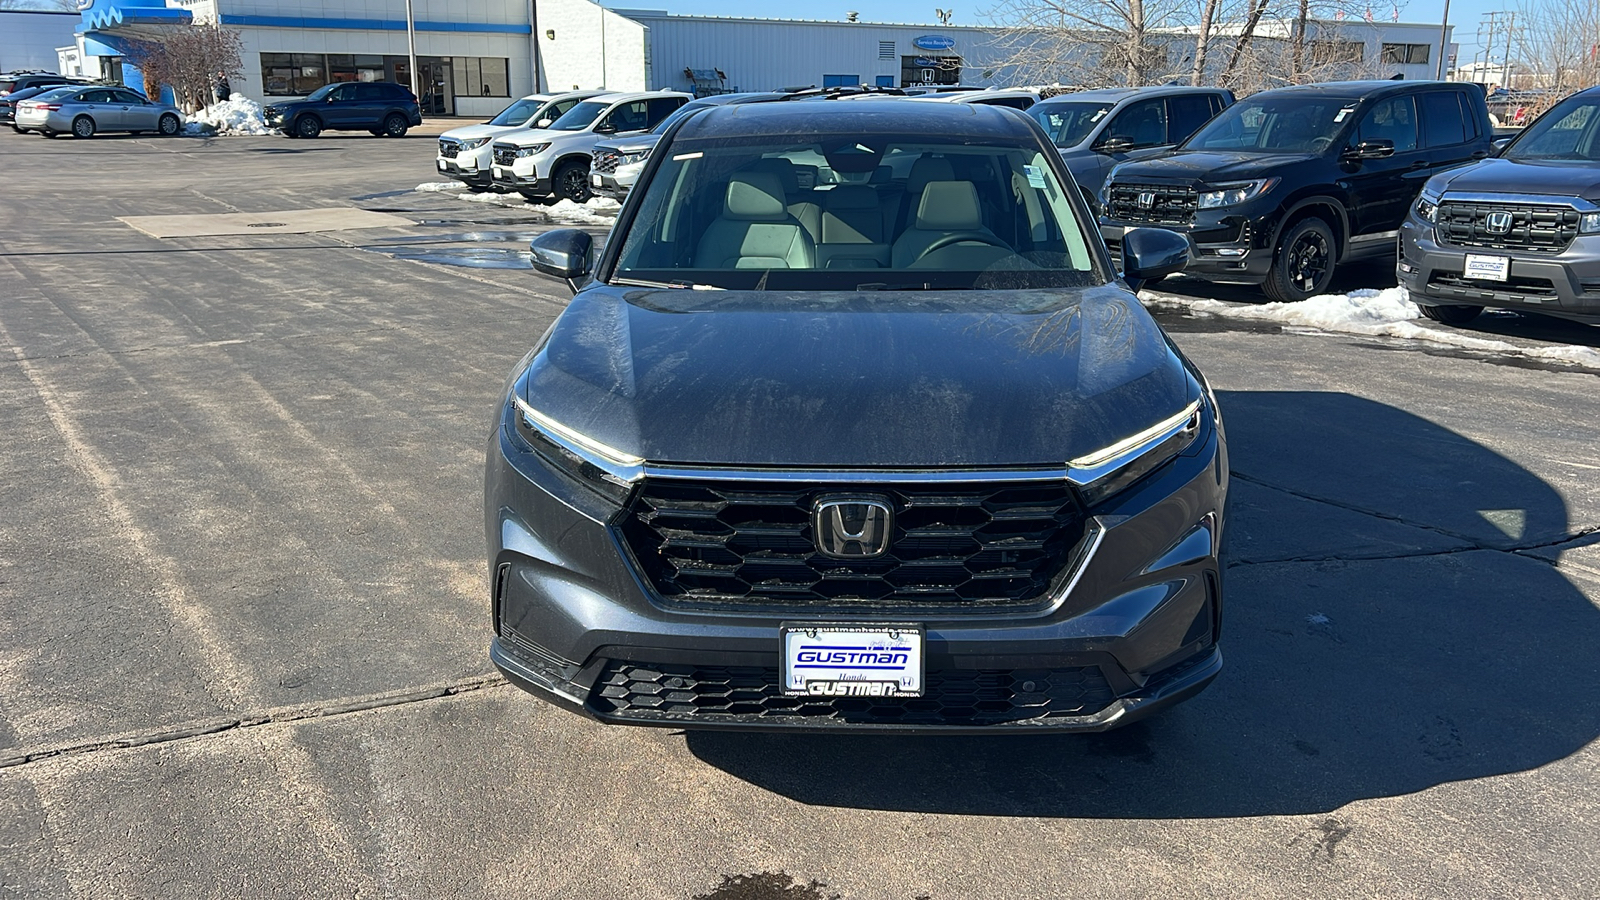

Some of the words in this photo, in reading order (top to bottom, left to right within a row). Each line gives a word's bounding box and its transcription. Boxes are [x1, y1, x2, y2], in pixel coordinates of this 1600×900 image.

[797, 651, 908, 664] GUSTman
[838, 673, 867, 681] Honda
[809, 682, 895, 696] GUSTman
